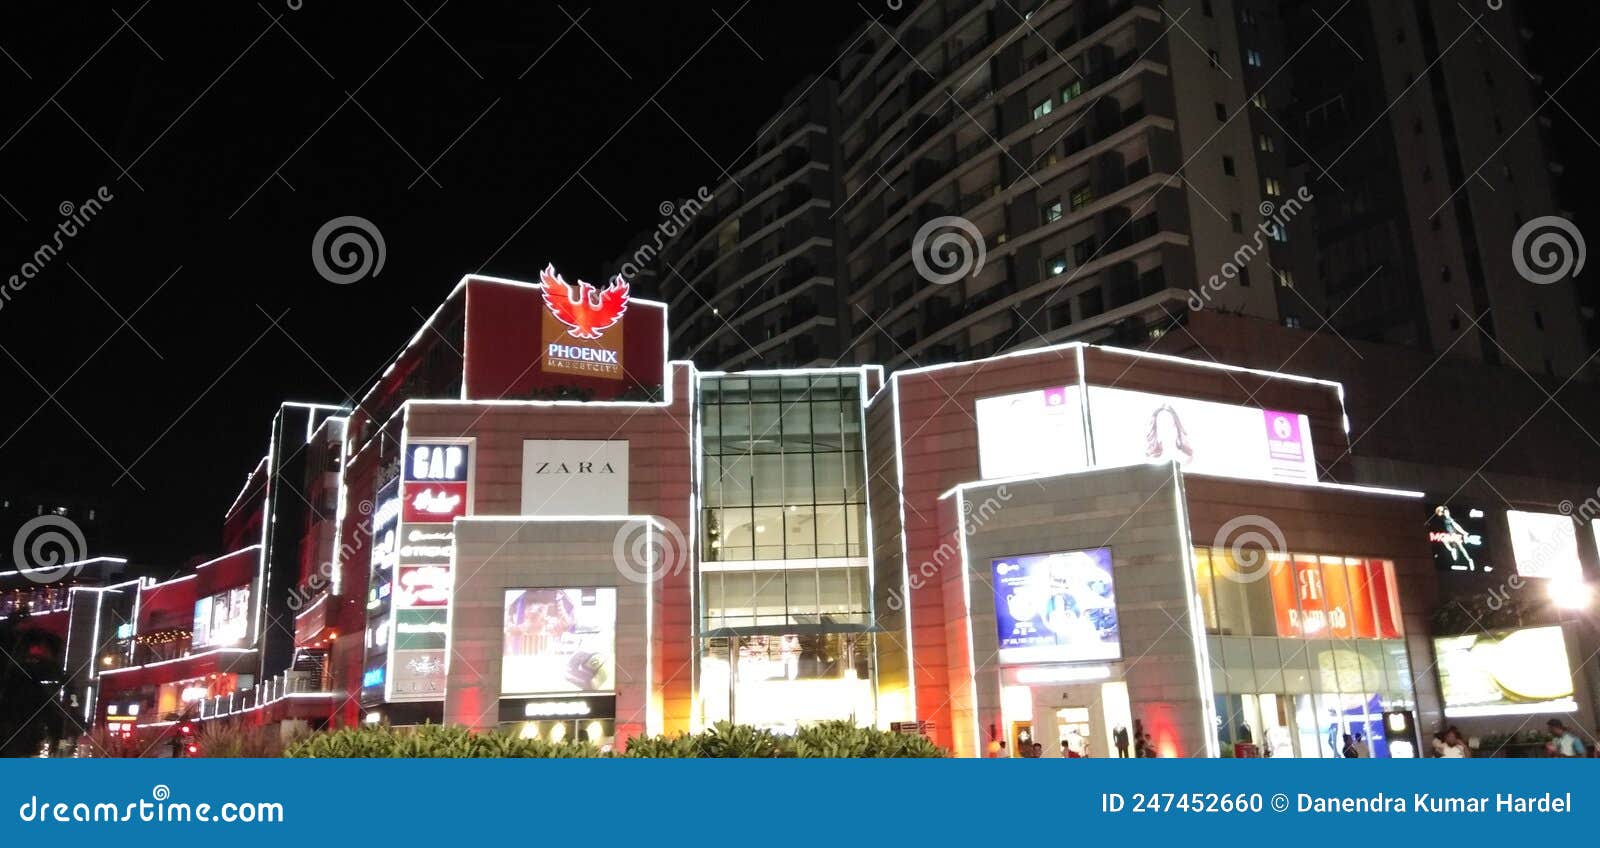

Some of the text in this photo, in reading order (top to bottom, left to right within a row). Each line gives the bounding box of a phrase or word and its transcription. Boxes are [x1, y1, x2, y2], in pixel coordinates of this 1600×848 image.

[548, 344, 617, 363] PHOENIX
[413, 447, 462, 479] GAP
[535, 461, 616, 474] ZARA
